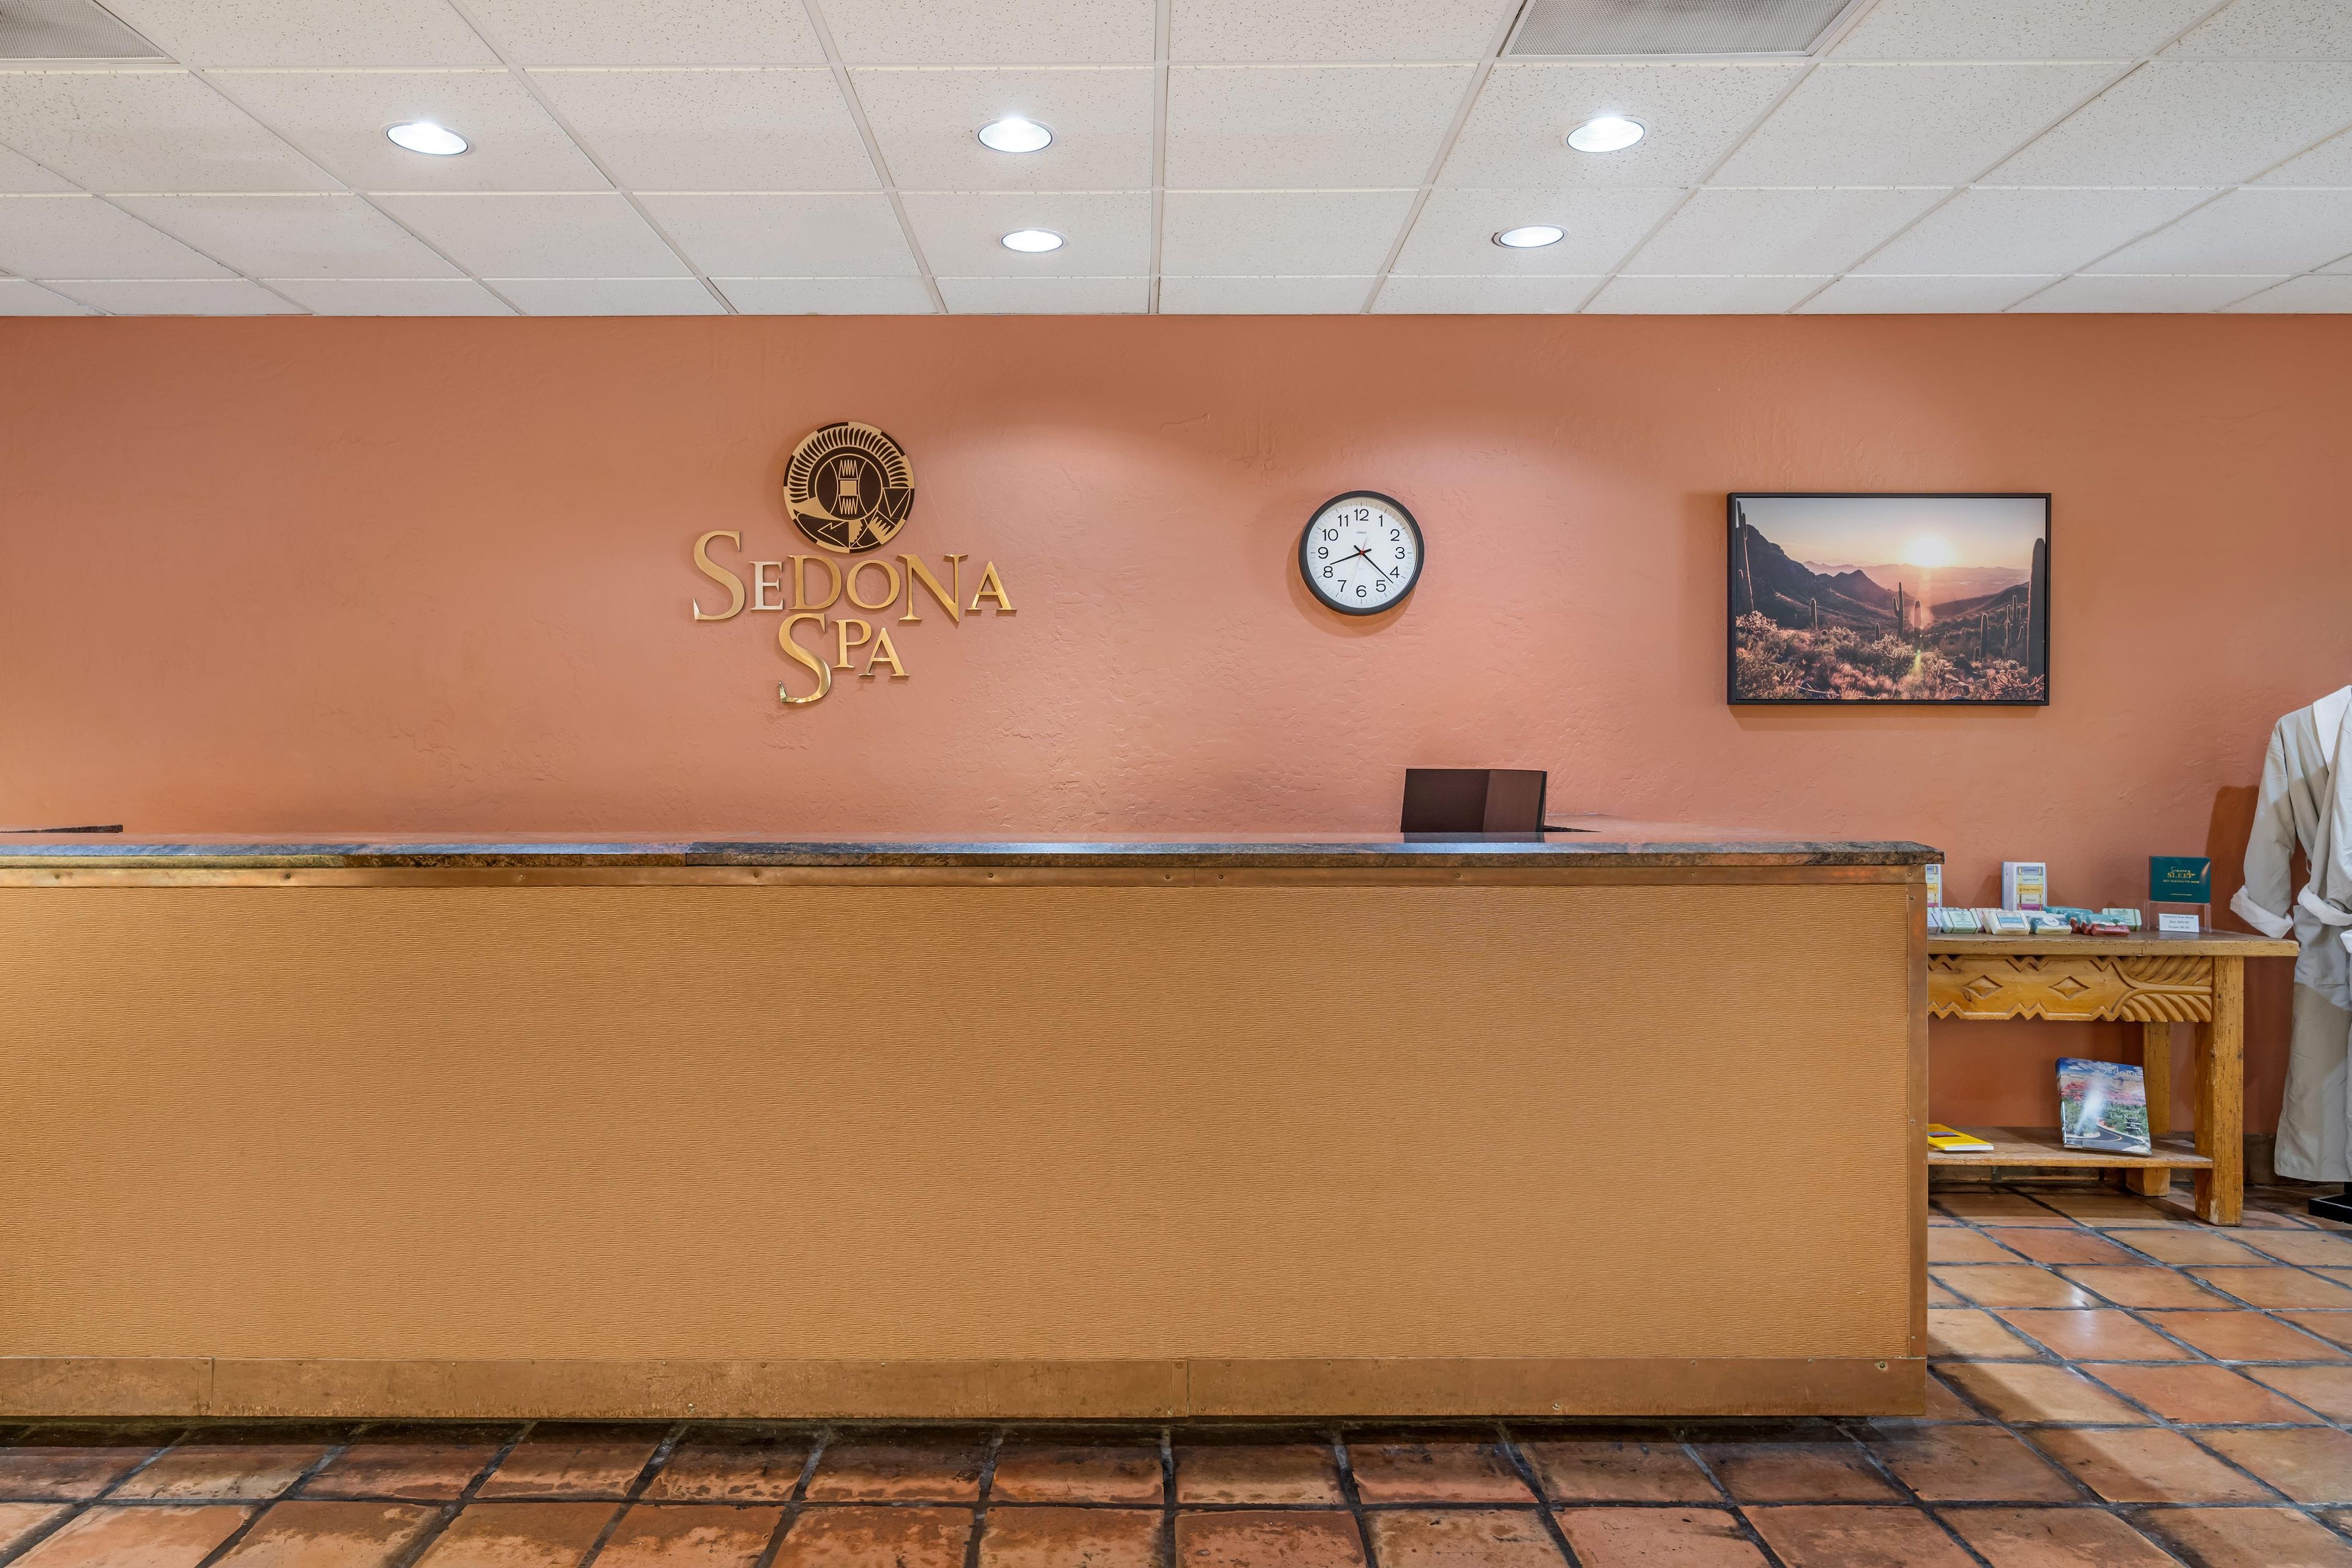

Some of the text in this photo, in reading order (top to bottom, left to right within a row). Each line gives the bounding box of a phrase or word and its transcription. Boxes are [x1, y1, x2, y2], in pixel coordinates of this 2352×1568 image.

[1338, 514, 1349, 527] 11
[1354, 508, 1369, 521] 12
[1379, 514, 1383, 527] 1
[1322, 529, 1339, 541] 10
[1390, 529, 1400, 541] 2
[1317, 547, 1329, 559] 9
[1395, 547, 1405, 559] 3
[693, 530, 1017, 623] SEDONA
[1323, 566, 1333, 578] 8
[1390, 566, 1400, 578] 4
[1338, 580, 1347, 592] 7
[1356, 585, 1366, 597] 6
[1376, 580, 1386, 592] 5
[778, 613, 910, 703] SPA
[2097, 1065, 2138, 1077] Sedona
